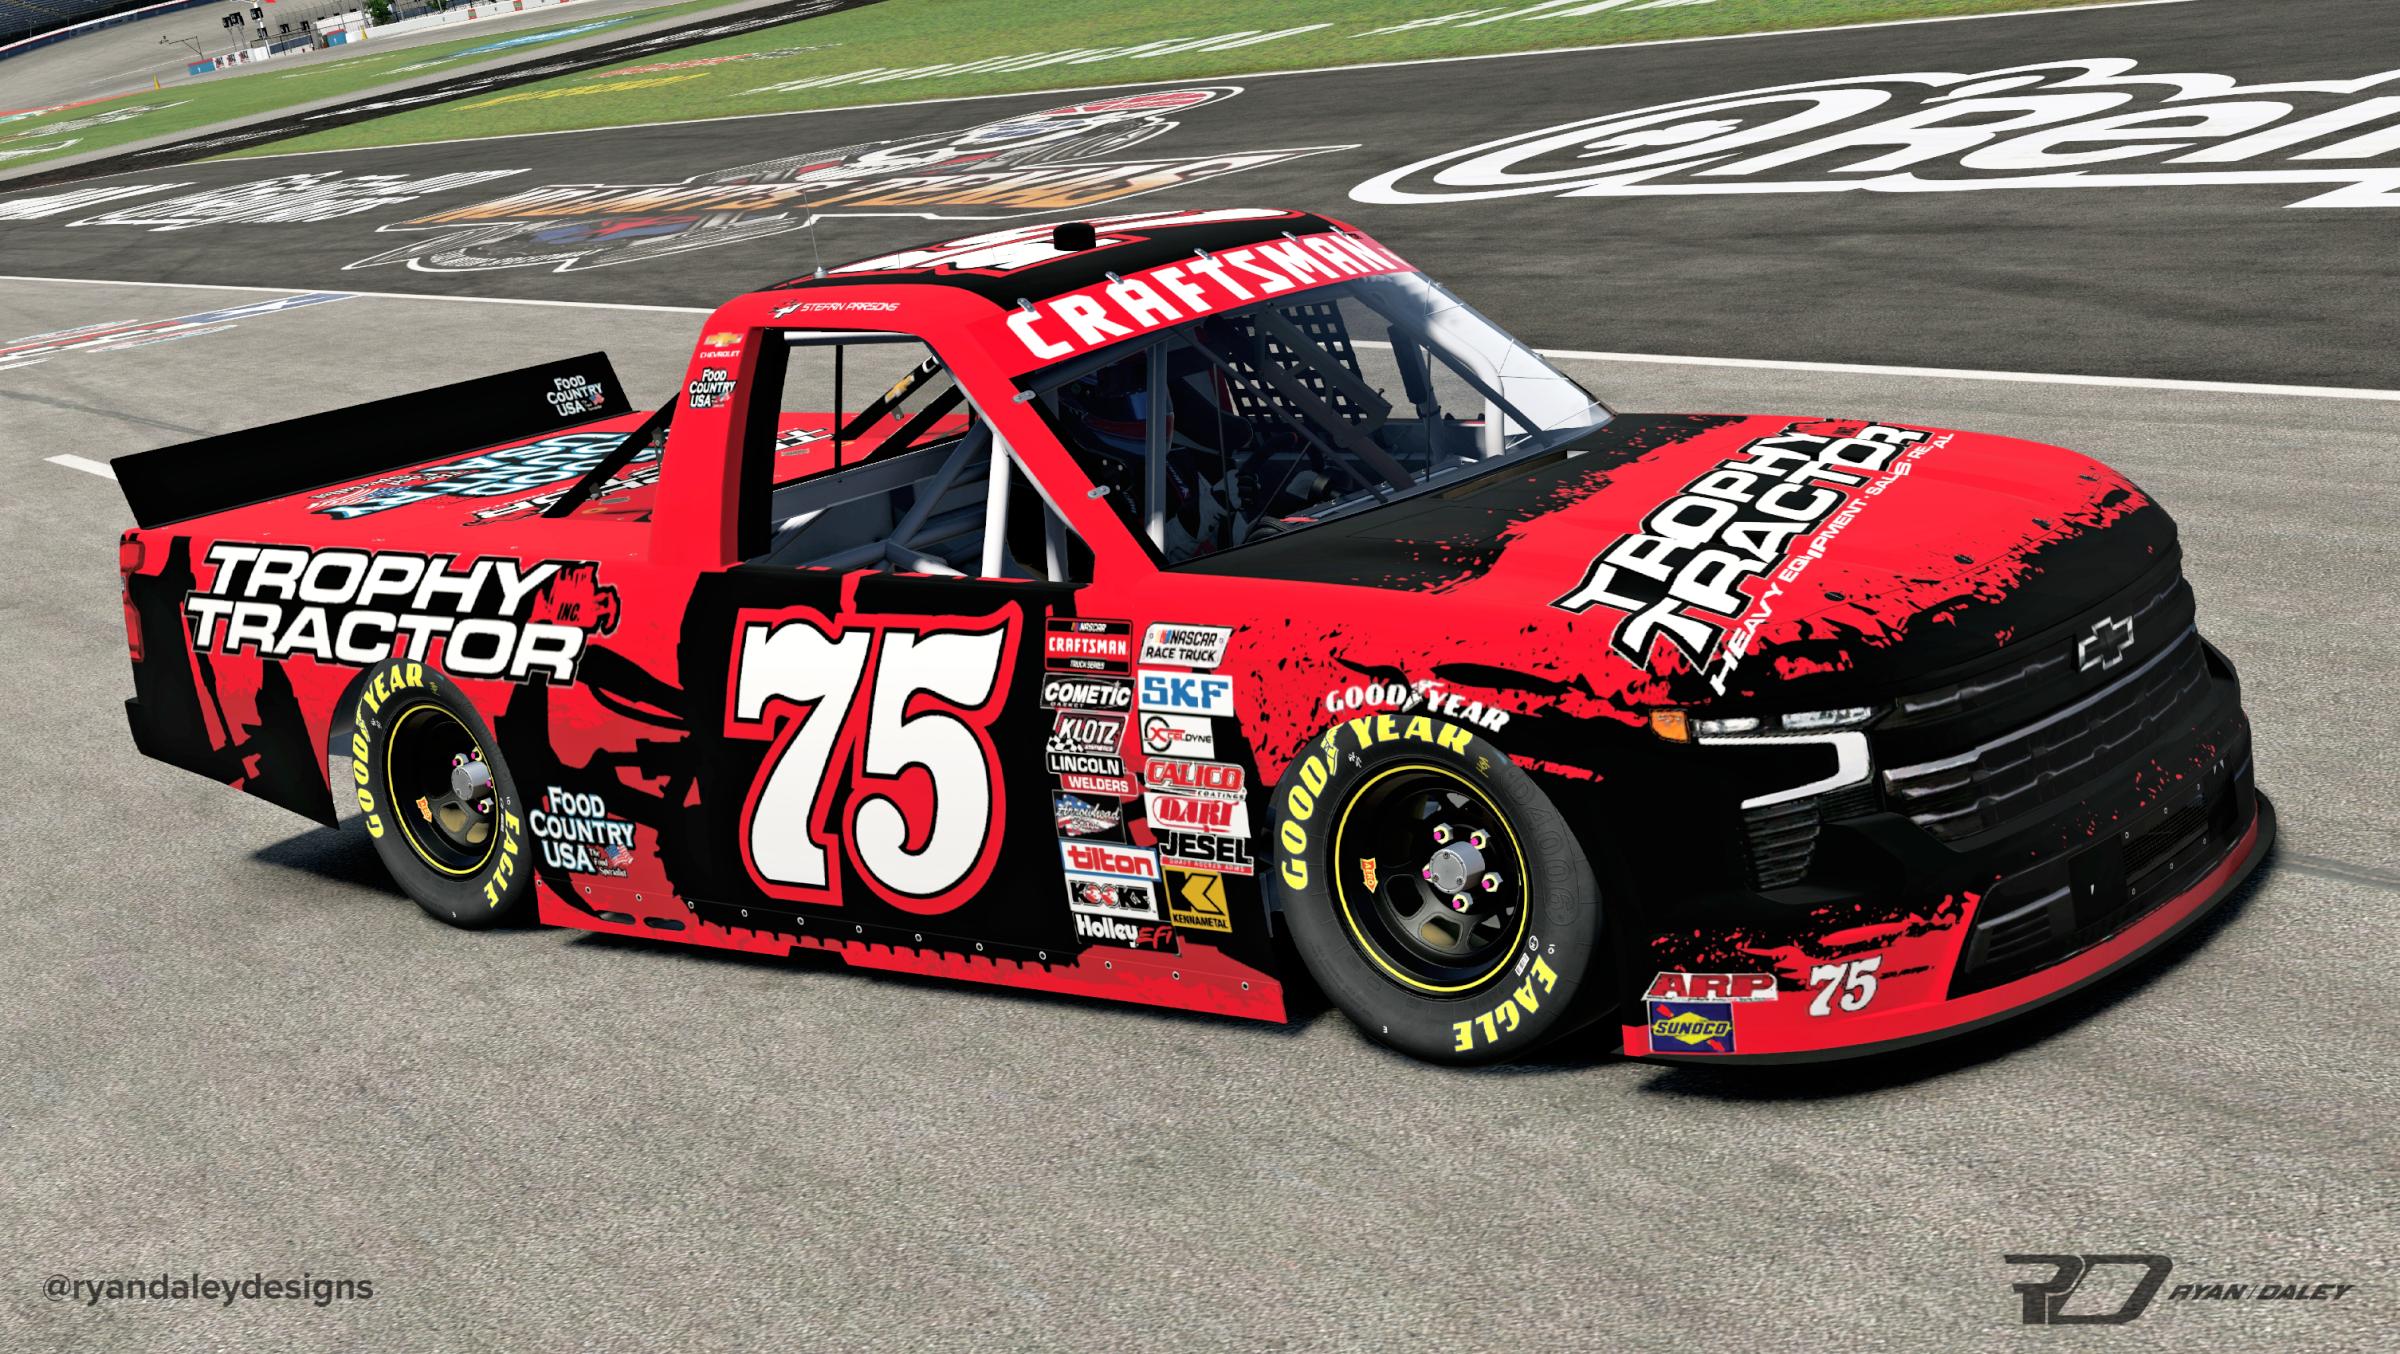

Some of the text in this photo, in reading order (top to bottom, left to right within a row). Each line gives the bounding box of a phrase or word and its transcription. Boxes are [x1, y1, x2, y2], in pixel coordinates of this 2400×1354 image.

[801, 301, 900, 312] STEFAN PARSONS
[1006, 233, 1398, 360] CRAFTSMAN
[553, 374, 586, 391] FOOD
[689, 380, 737, 394] COUNTRY
[702, 368, 727, 382] FOOD
[546, 382, 603, 405] COUNTRY
[690, 394, 712, 408] USA
[556, 400, 586, 417] USA
[1560, 431, 1831, 613] TROPHY
[1621, 425, 1924, 674] TRACTOR
[208, 544, 562, 617] TROPHY
[1709, 581, 1784, 697] HEAVY
[1777, 498, 1868, 583] EQUIPMENT
[557, 602, 580, 622] INC.
[187, 597, 585, 681] TRACTOR
[1079, 622, 1107, 632] NASCAR
[1169, 629, 1218, 647] NASCAR
[1048, 636, 1127, 655] CRAFTSMAN
[1146, 646, 1217, 662] RACE TRUCK
[1044, 682, 1132, 706] COMETIC
[1142, 675, 1229, 709] SKF
[1325, 679, 1511, 732] GOODYEAR
[1058, 717, 1120, 745] KLOTZ
[736, 622, 1005, 896] 75
[1051, 754, 1120, 775] LINCOLN
[1068, 776, 1129, 792] WELDERS
[1147, 761, 1243, 791] CALICO
[547, 786, 606, 819] FOOD
[1197, 789, 1244, 800] COATINGS
[1160, 798, 1238, 826] DART
[529, 810, 635, 848] COUNTRY
[483, 809, 520, 909] EAGLE
[541, 839, 597, 874] USA
[1067, 844, 1154, 876] tilton
[1159, 831, 1253, 864] JESEL
[1069, 880, 1151, 912] KOOKS
[1075, 914, 1139, 948] Holley
[1172, 913, 1228, 928] KENNAMETAL
[1648, 973, 1775, 998] ARP
[1808, 954, 1883, 1017] 75
[1452, 954, 1559, 1053] EAGLE
[1655, 1021, 1730, 1035] SUNOCO
